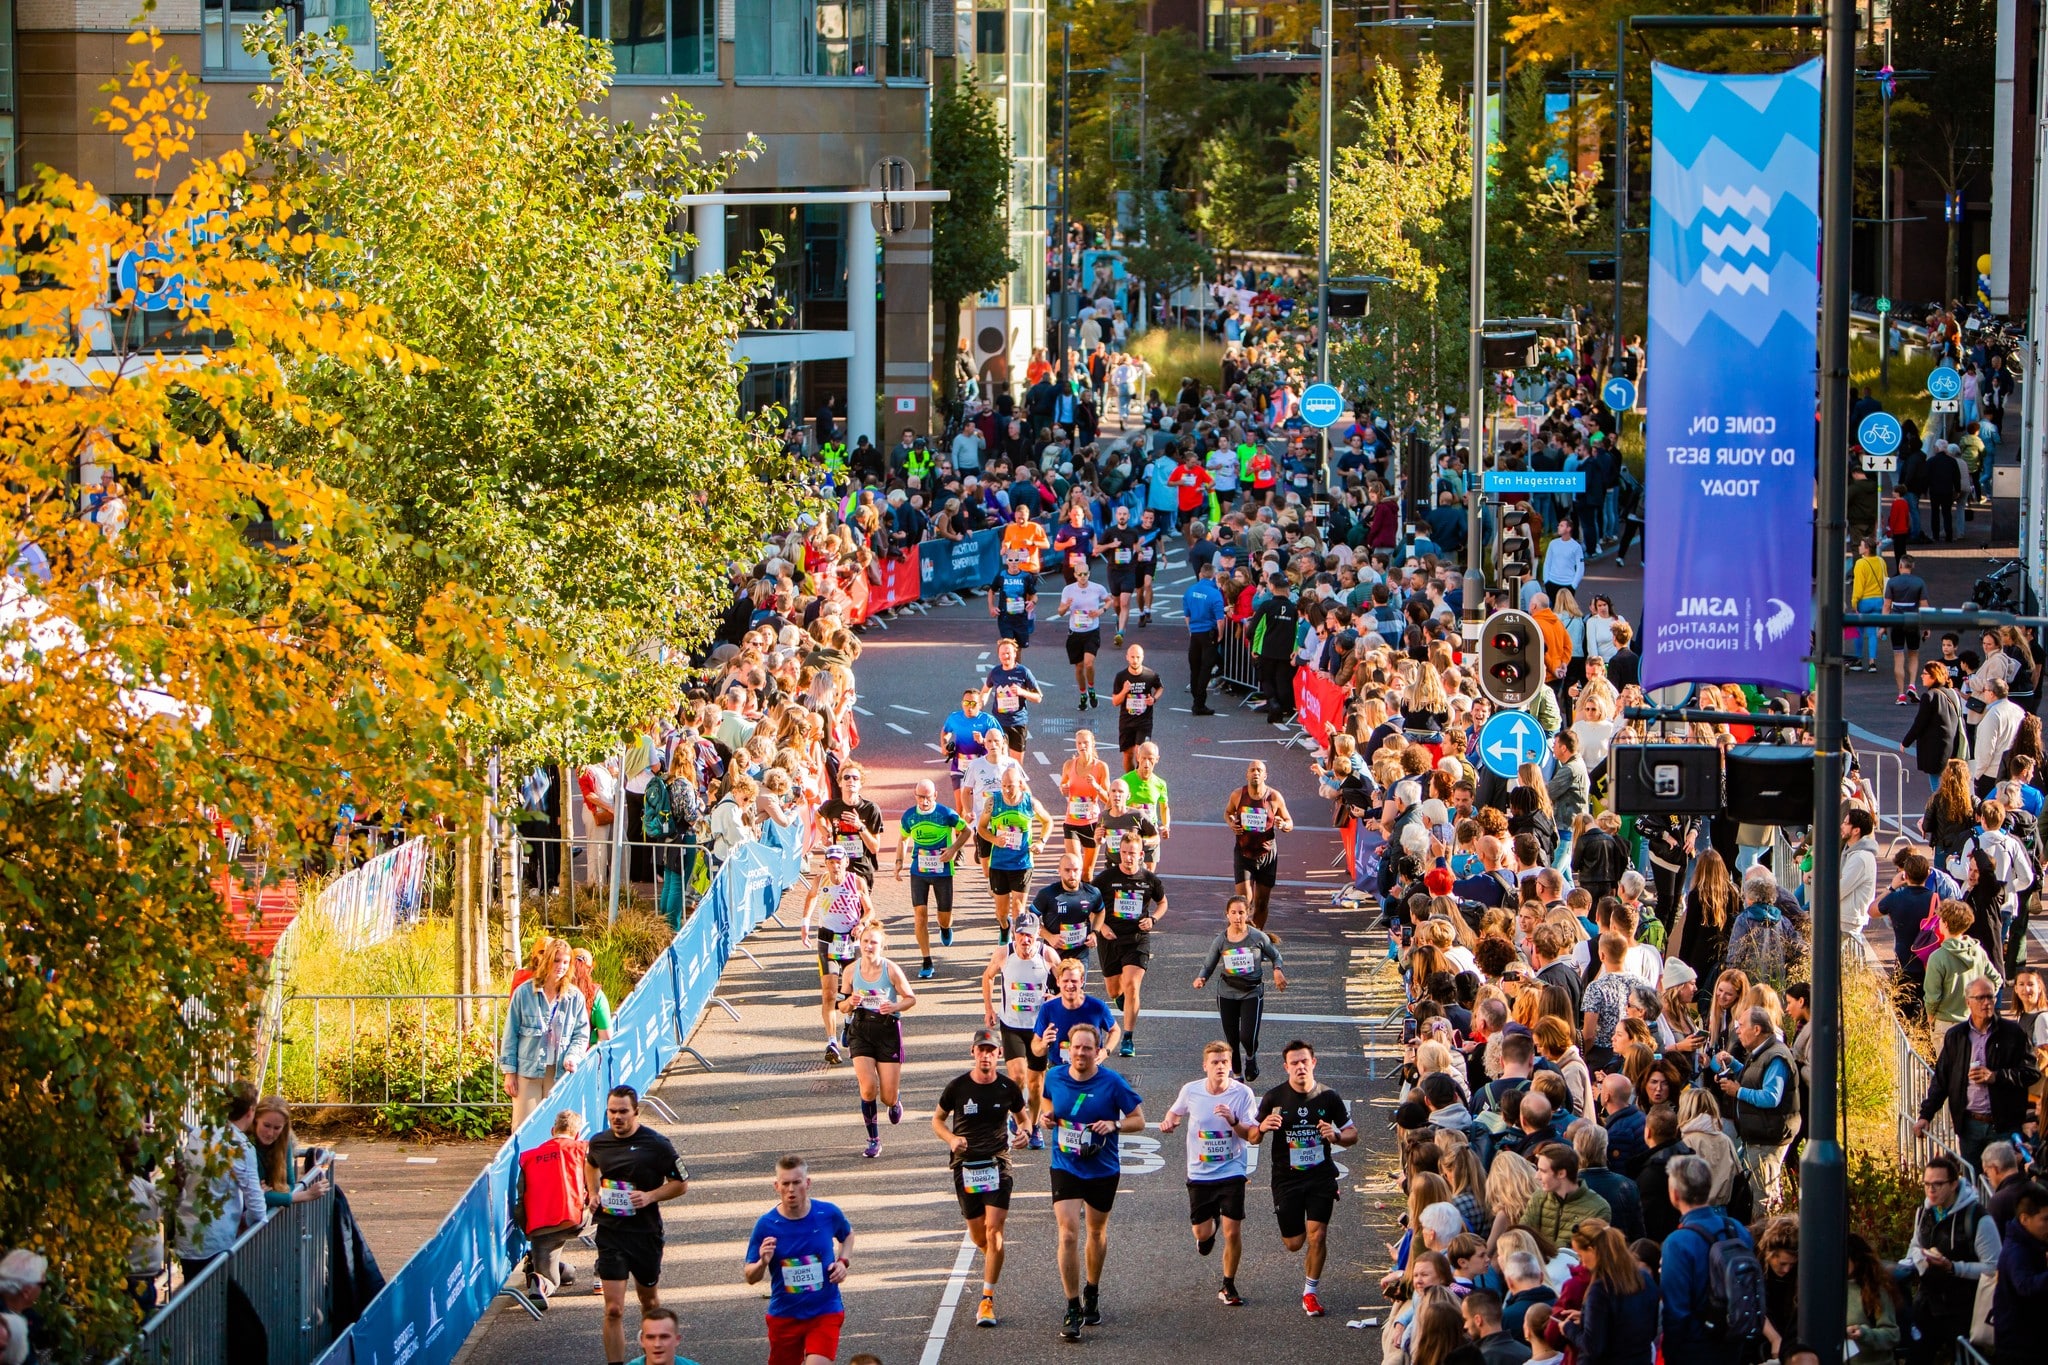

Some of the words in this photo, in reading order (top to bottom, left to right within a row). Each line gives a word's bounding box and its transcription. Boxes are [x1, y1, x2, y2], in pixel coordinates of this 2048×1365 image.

[1493, 475, 1512, 485] Ten
[1515, 475, 1577, 488] Hagestraat
[1004, 578, 1024, 586] ASML
[1504, 615, 1520, 623] 43.1
[1504, 693, 1520, 701] 42.1
[1057, 905, 1068, 914] MH
[1207, 1146, 1224, 1154] 5160
[536, 1151, 561, 1163] PER
[971, 1174, 991, 1183] 10287
[608, 1197, 629, 1206] 10136
[792, 1272, 815, 1283] 10231
